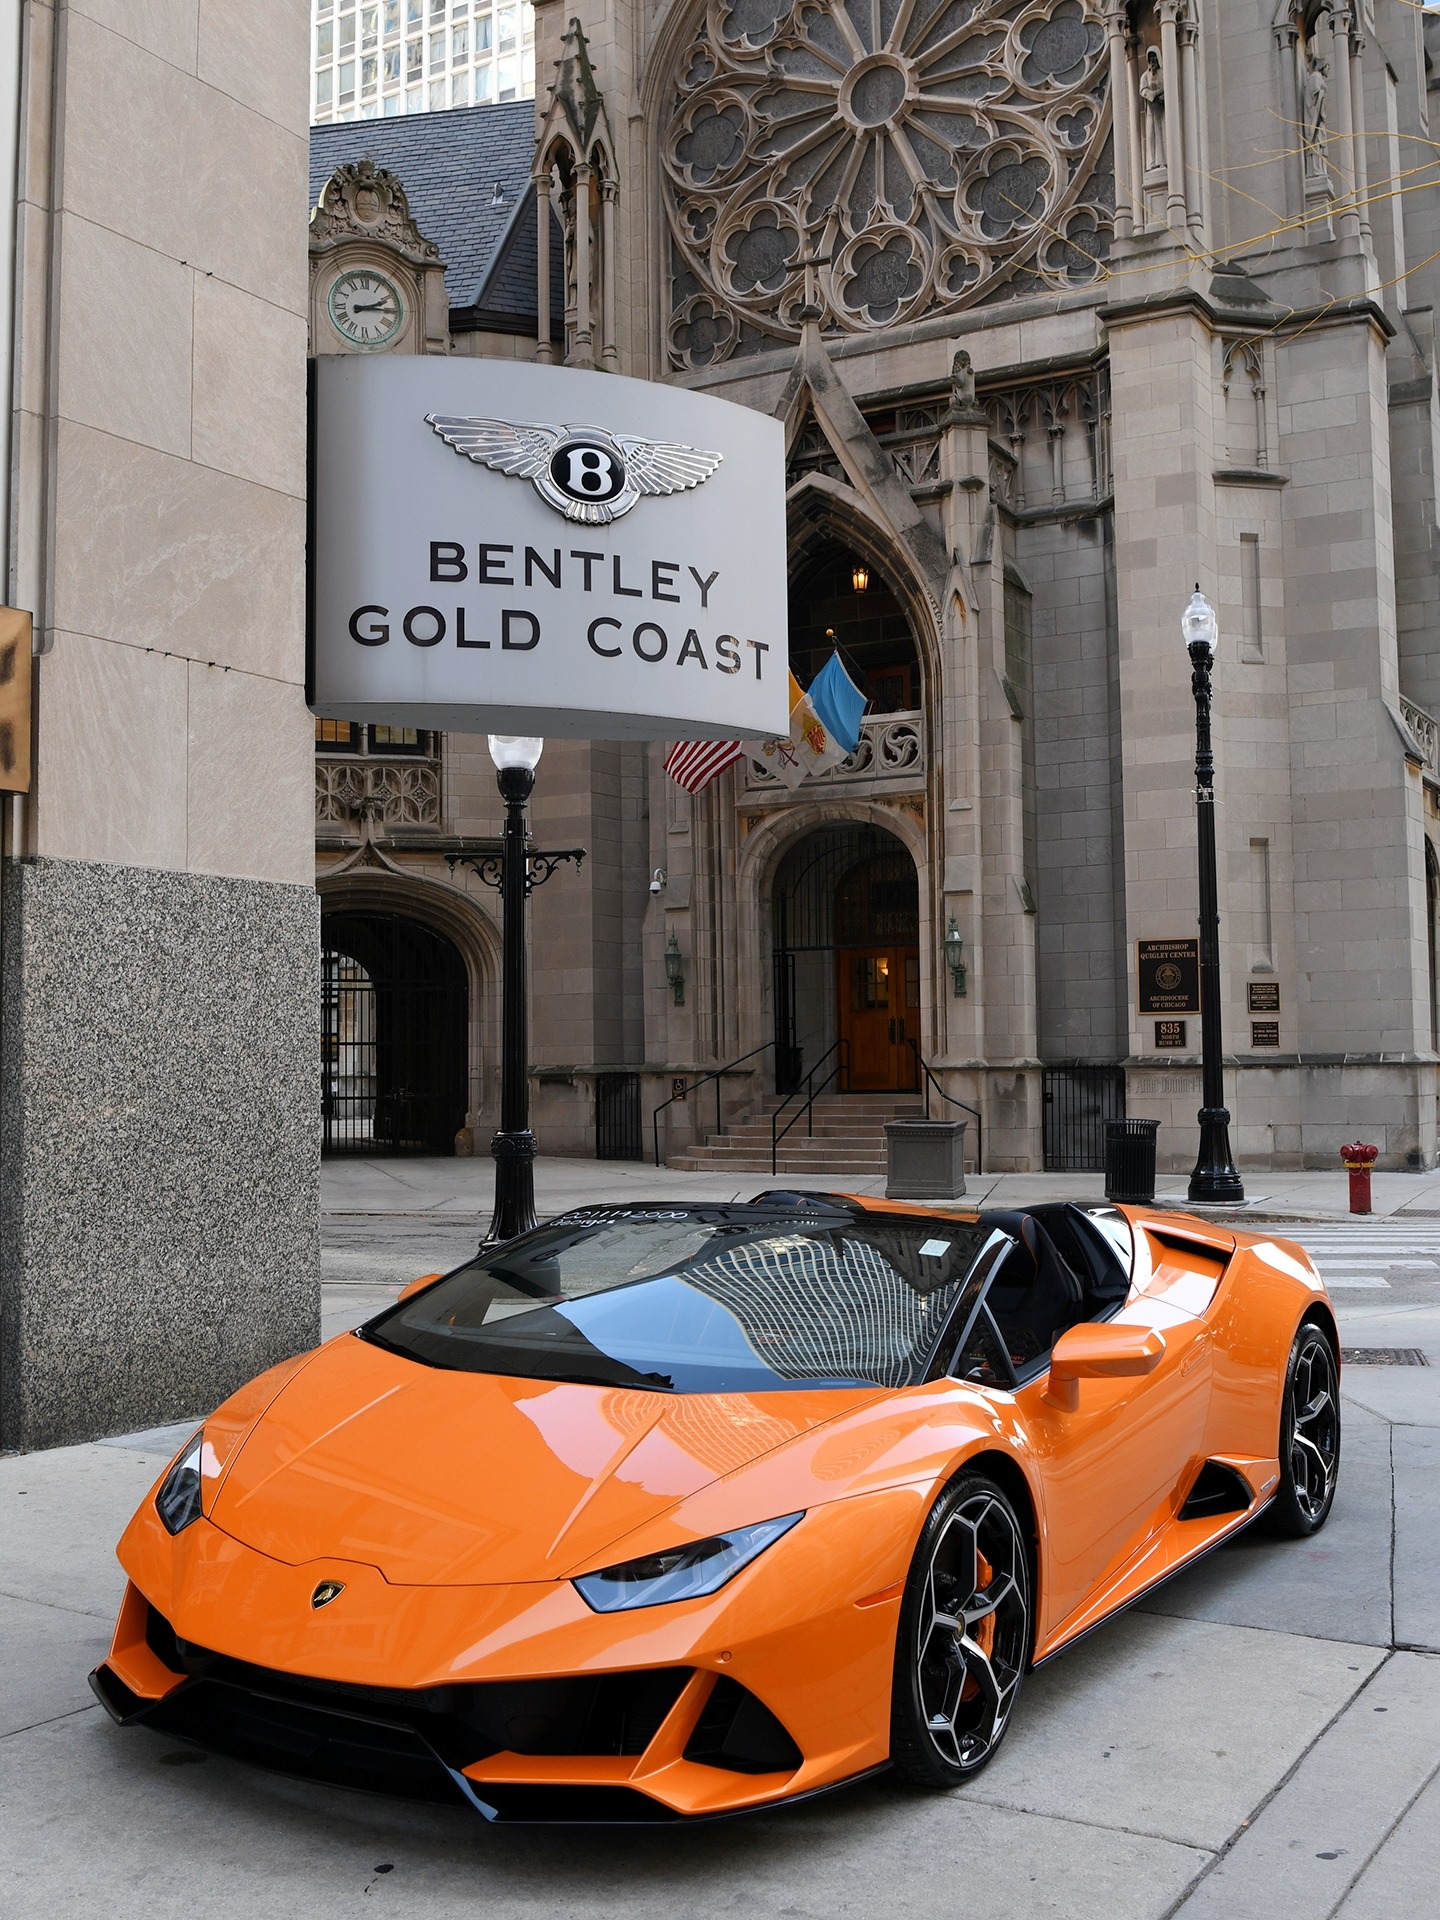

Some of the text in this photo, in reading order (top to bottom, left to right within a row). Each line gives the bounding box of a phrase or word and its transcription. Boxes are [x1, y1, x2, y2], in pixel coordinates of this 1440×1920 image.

[565, 447, 613, 497] B
[429, 541, 720, 608] BENTLEY
[348, 605, 770, 681] GOLD COAST
[1140, 951, 1196, 960] QUIGLEY CENTER
[1160, 1022, 1180, 1034] 835
